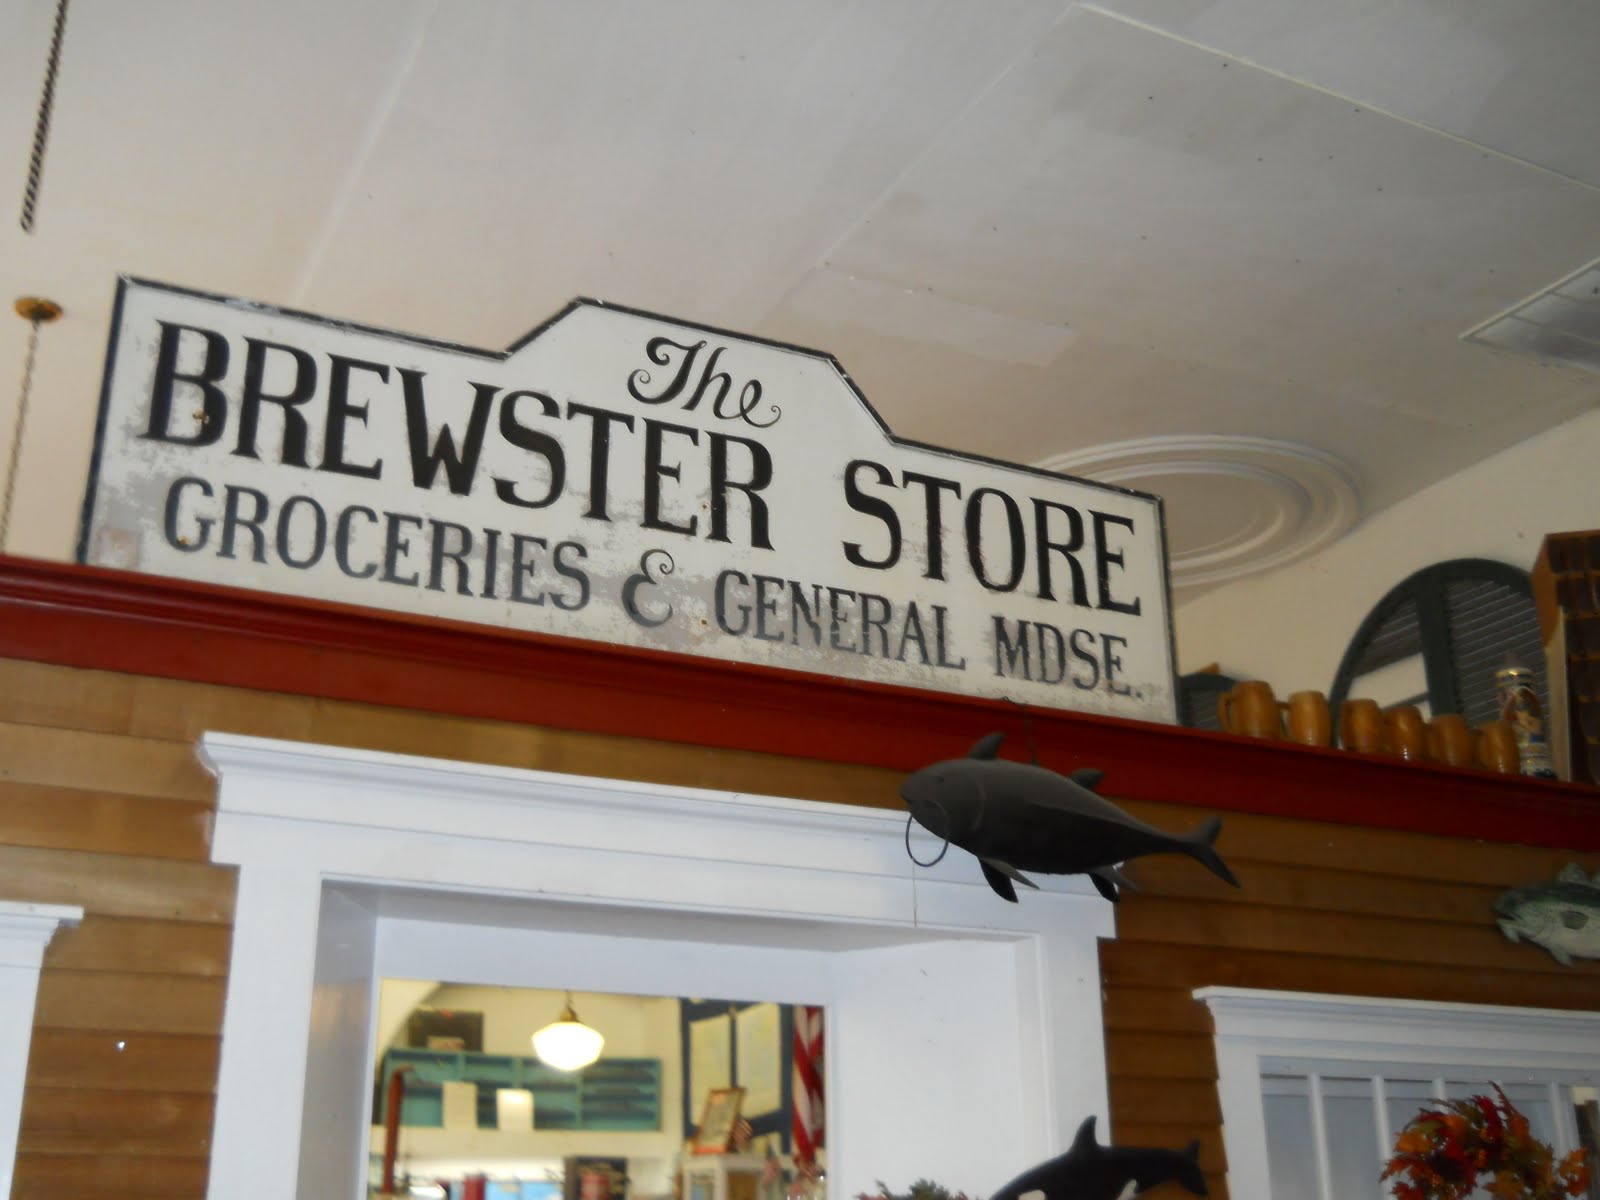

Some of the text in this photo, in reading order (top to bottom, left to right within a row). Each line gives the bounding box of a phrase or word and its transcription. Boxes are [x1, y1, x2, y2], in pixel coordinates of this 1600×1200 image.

[136, 319, 1142, 617] BREWSTER STORE
[627, 336, 781, 428] The
[163, 476, 1143, 699] GROCERIES & GENERAL MDSE.
